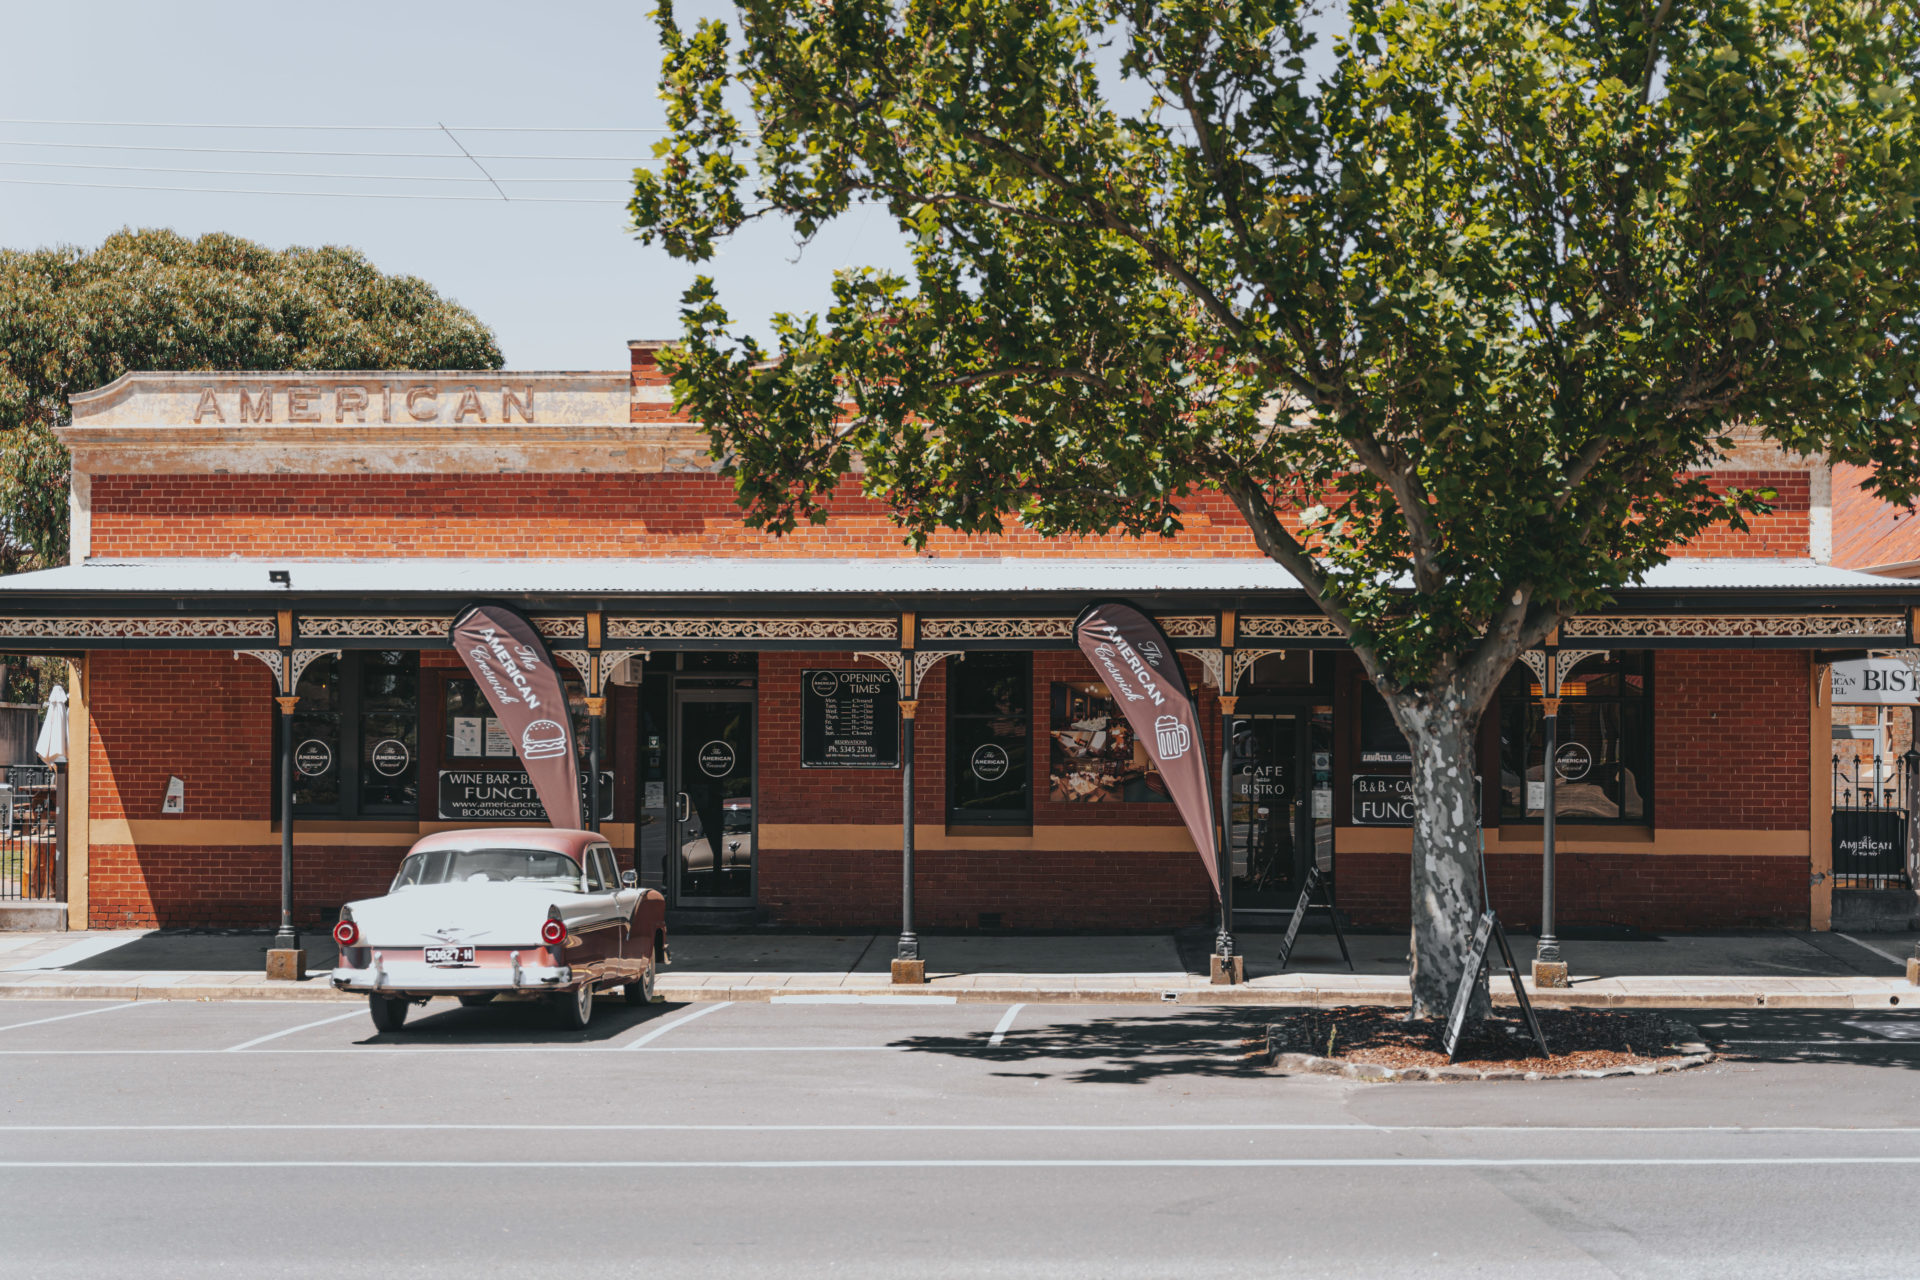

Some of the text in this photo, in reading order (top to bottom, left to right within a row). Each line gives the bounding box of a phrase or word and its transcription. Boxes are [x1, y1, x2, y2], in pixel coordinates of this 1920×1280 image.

[193, 384, 535, 424] AMERICAN
[514, 645, 540, 670] The
[1137, 641, 1163, 666] The
[470, 645, 520, 704] Creswick
[480, 628, 541, 709] AMERICAN
[1095, 642, 1145, 701] Creswick
[1102, 626, 1165, 706] AMERICAN
[840, 673, 891, 683] OPENING
[850, 684, 881, 694] TIMES
[449, 774, 483, 784] WINE
[486, 774, 510, 784] BAR
[1242, 766, 1283, 777] CAFE
[1241, 784, 1284, 795] BISTRO
[1370, 782, 1376, 792] &
[1395, 780, 1412, 792] CA
[462, 808, 516, 817] BOOKINGS
[519, 808, 537, 817] ON
